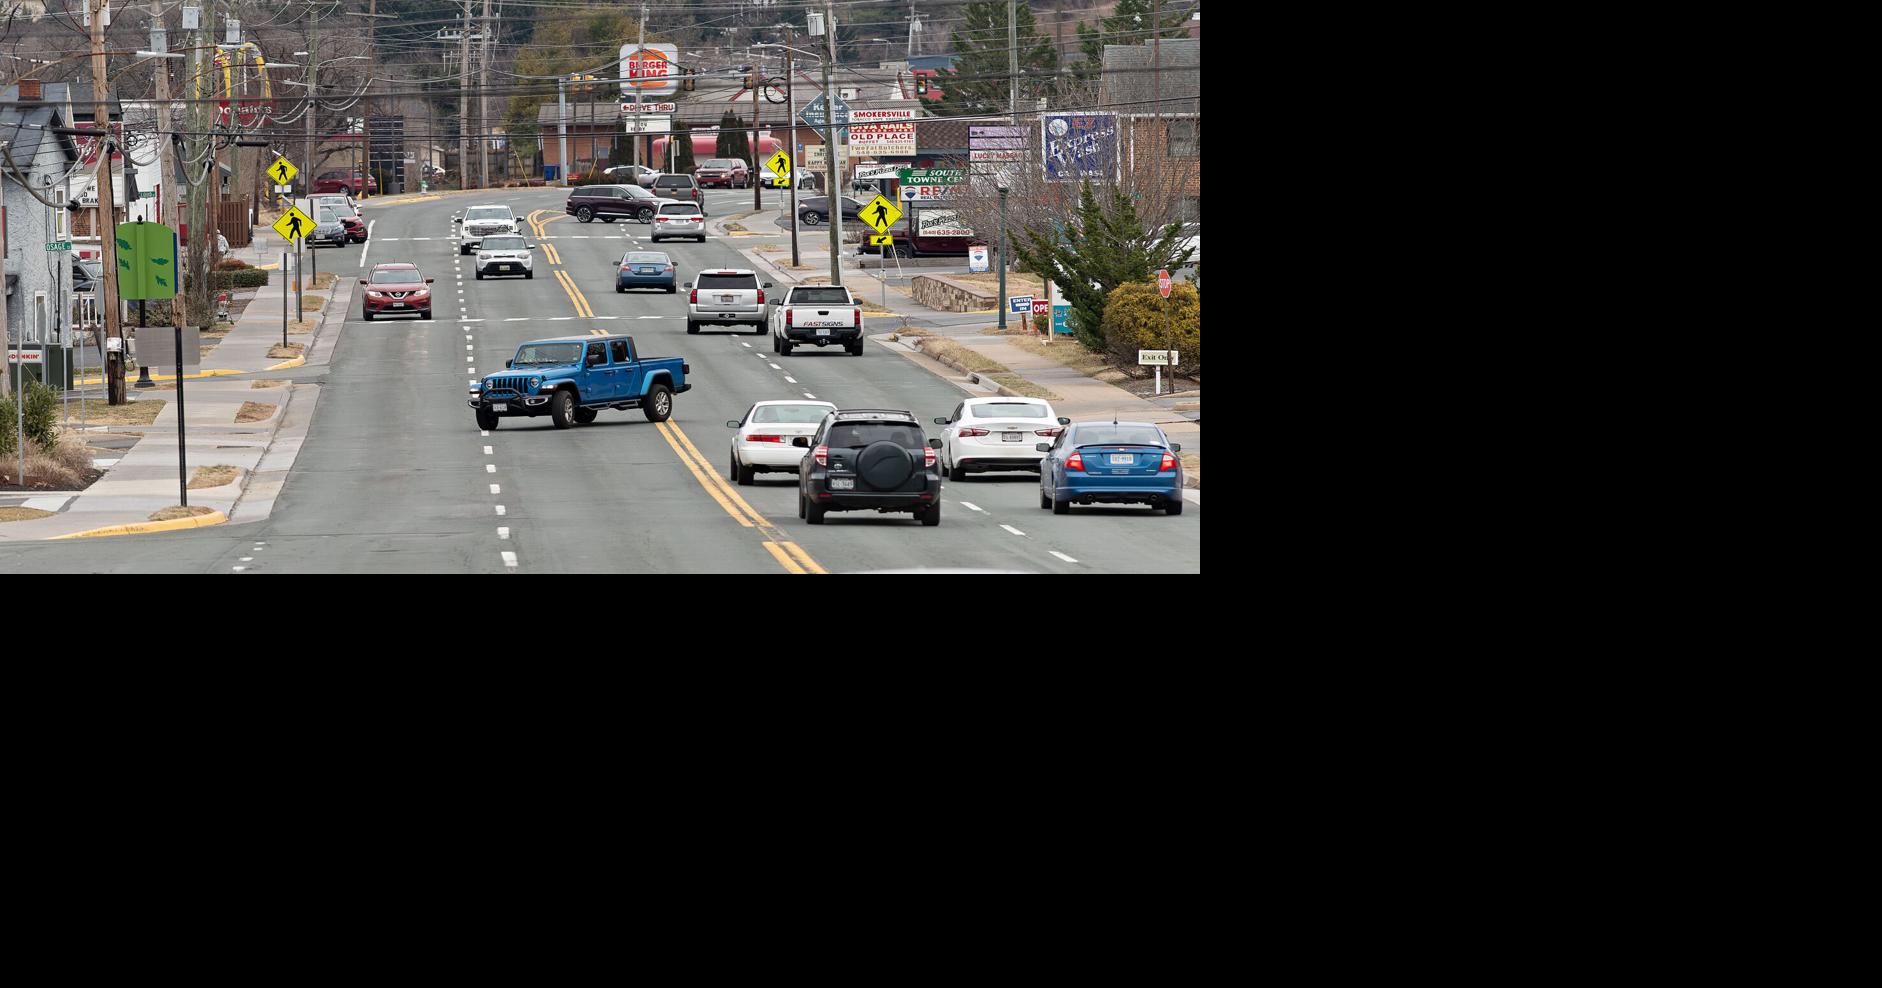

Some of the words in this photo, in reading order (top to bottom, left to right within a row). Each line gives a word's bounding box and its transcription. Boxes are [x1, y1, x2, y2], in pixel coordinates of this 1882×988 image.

[656, 103, 674, 111] THRU
[879, 122, 913, 130] NAILS
[1160, 278, 1171, 289] STOP
[1033, 303, 1049, 314] OPE
[1143, 354, 1156, 362] Exit
